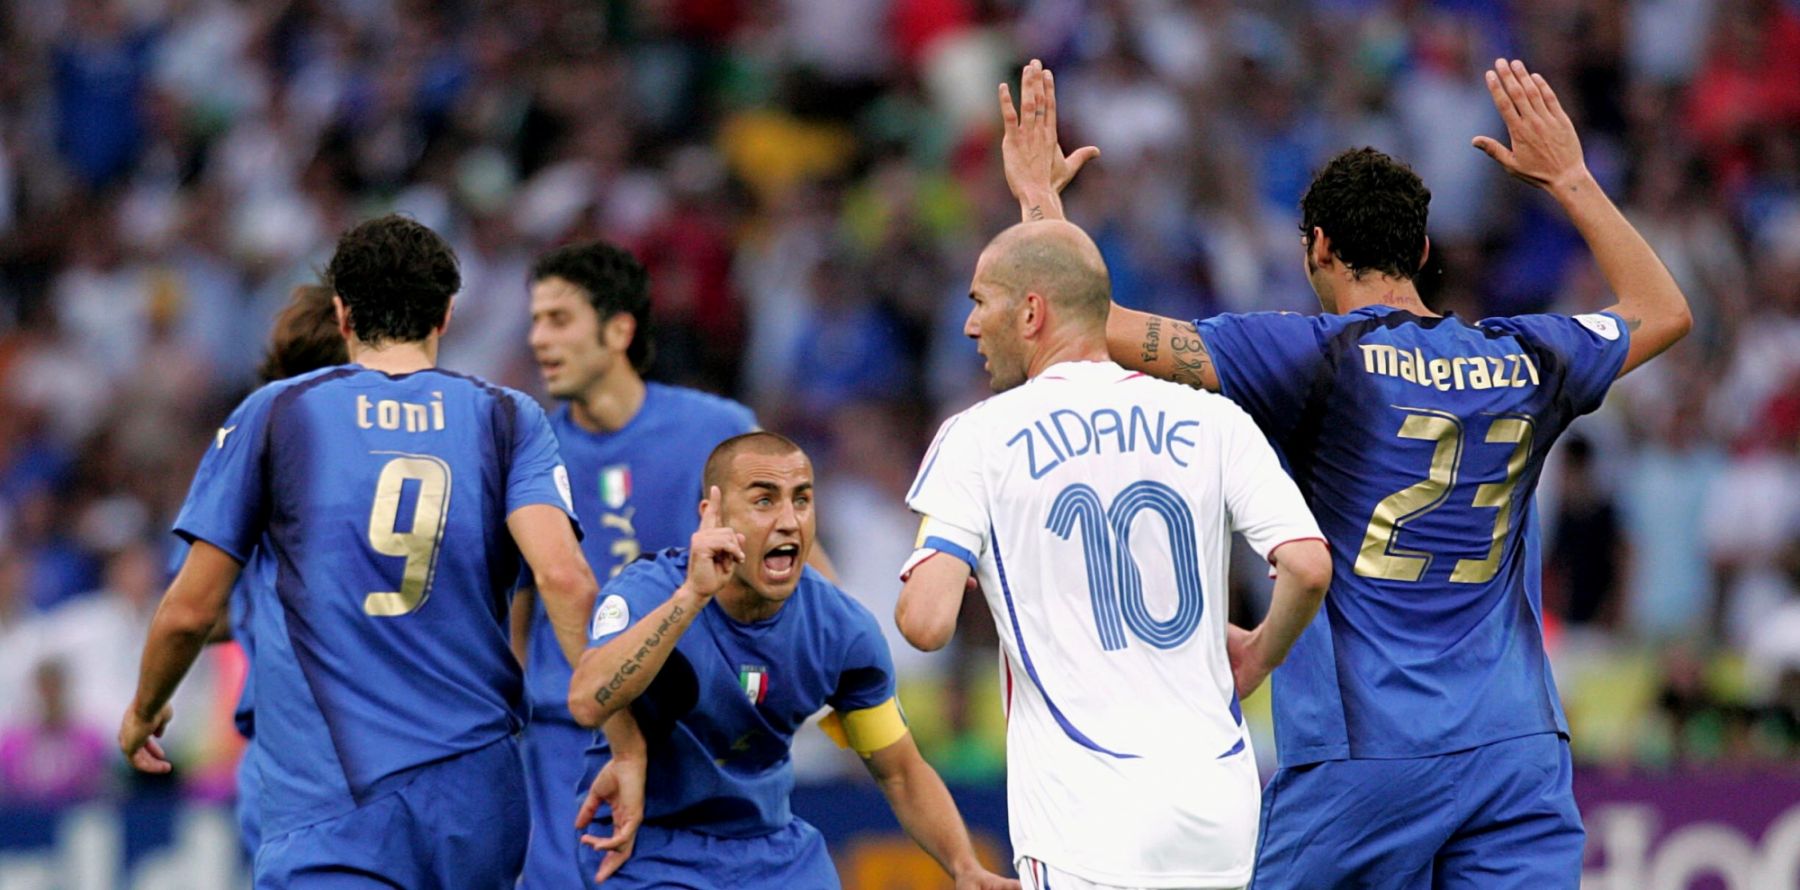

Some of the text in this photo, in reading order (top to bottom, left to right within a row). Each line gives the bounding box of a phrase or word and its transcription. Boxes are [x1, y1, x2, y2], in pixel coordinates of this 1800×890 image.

[357, 390, 445, 433] toni
[1006, 405, 1200, 480] ZIDANE
[1353, 404, 1536, 584] 23
[364, 451, 452, 617] 9
[1045, 480, 1204, 651] 10
